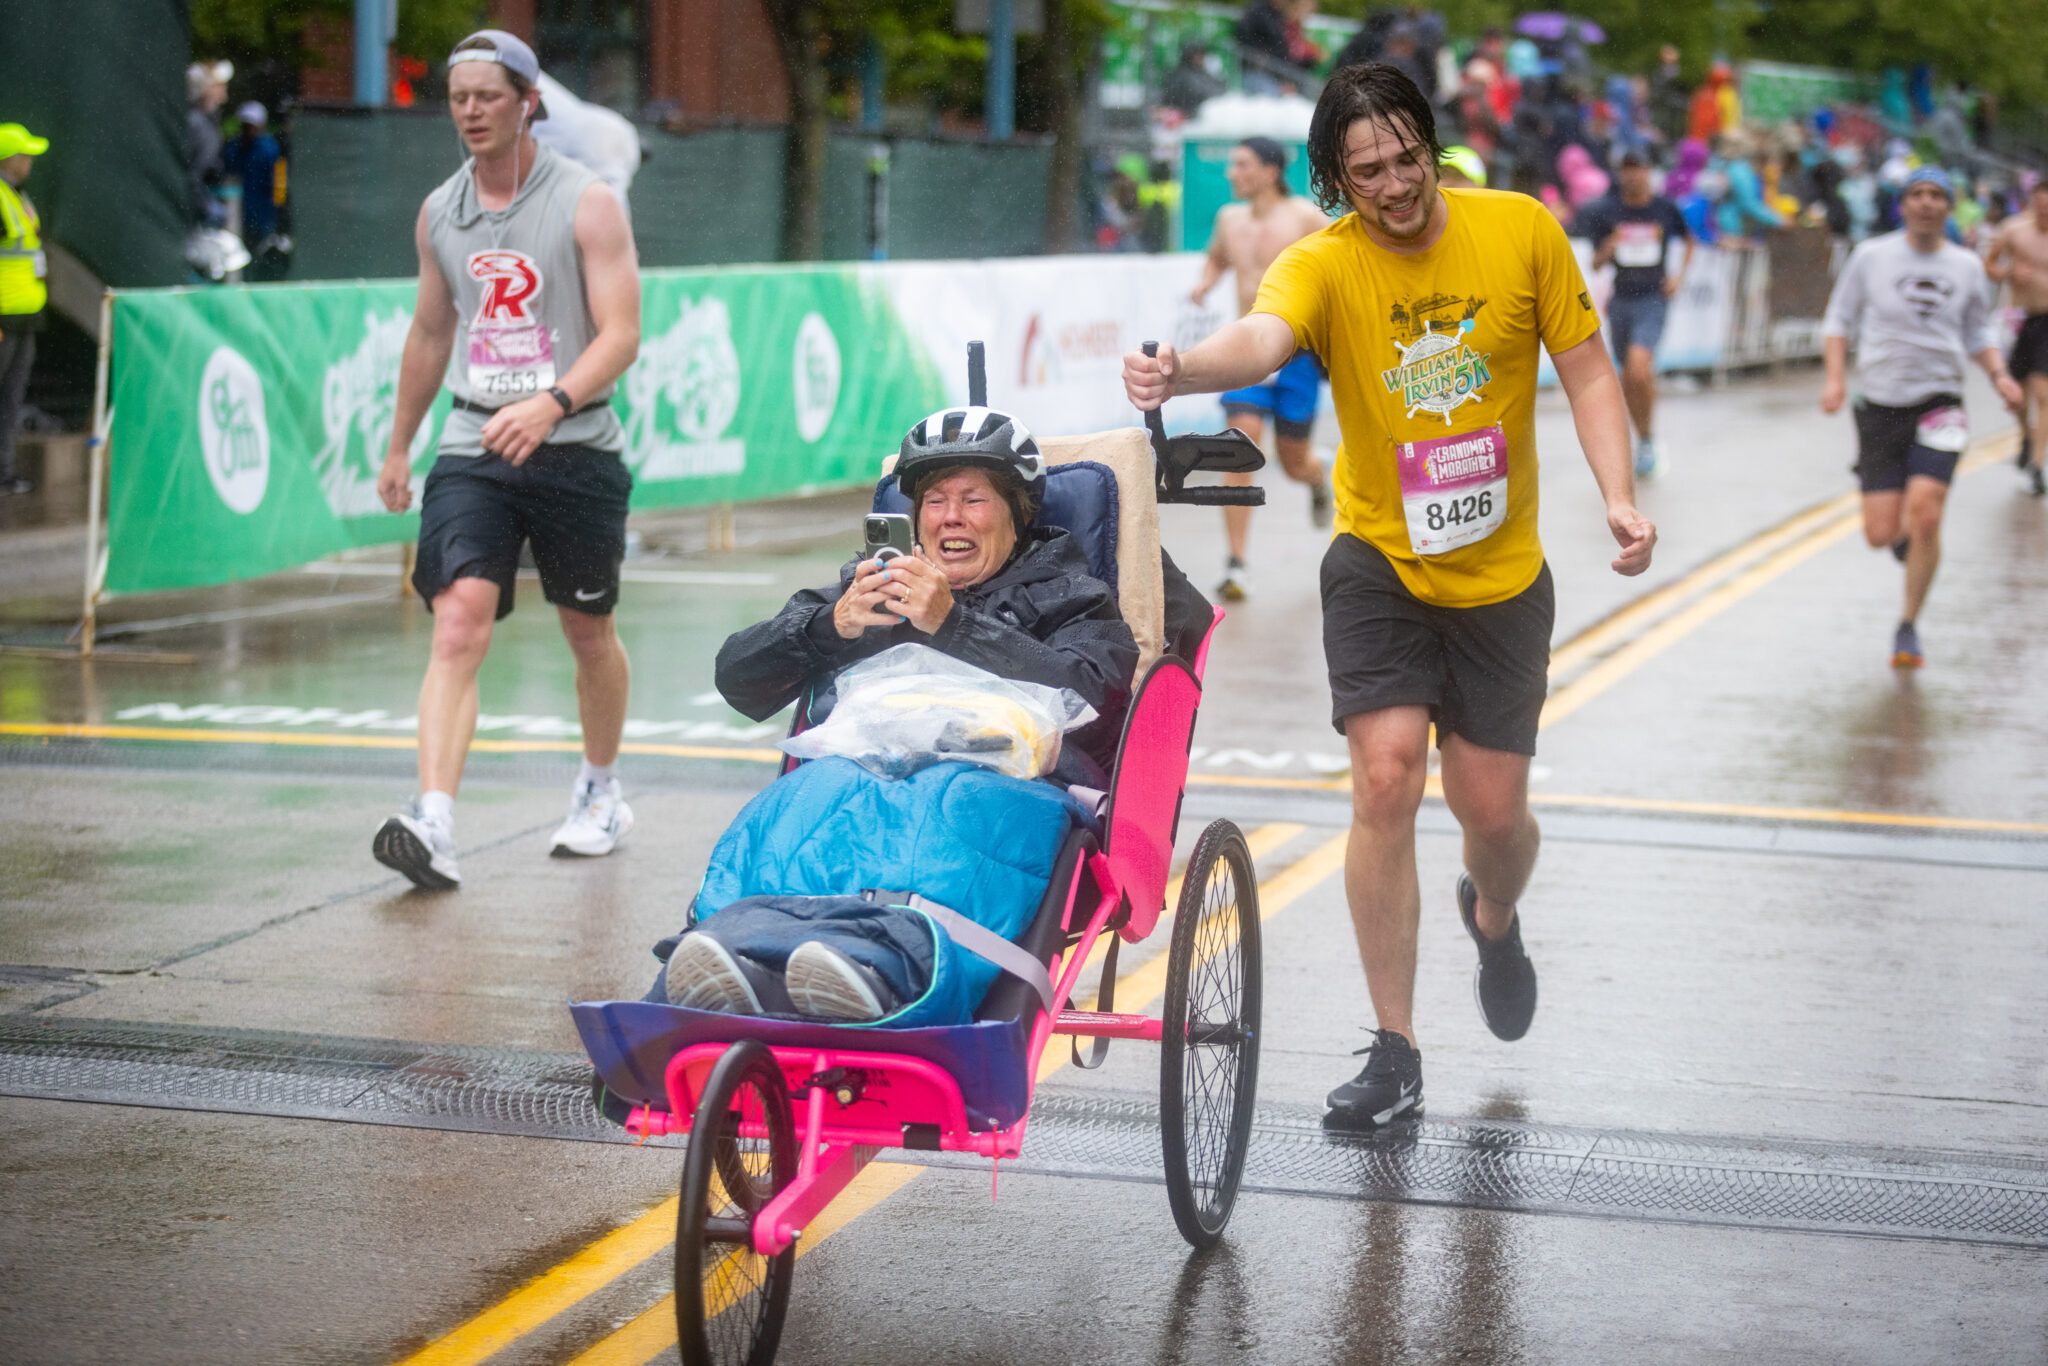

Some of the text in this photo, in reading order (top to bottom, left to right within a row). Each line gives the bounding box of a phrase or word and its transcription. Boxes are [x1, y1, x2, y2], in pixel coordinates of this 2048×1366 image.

[485, 371, 539, 395] 7553
[1382, 349, 1459, 393] WILLIAM
[1404, 353, 1492, 408] IRVIN 5K
[1436, 436, 1495, 463] GRANDMA'S
[1426, 490, 1493, 531] 8426
